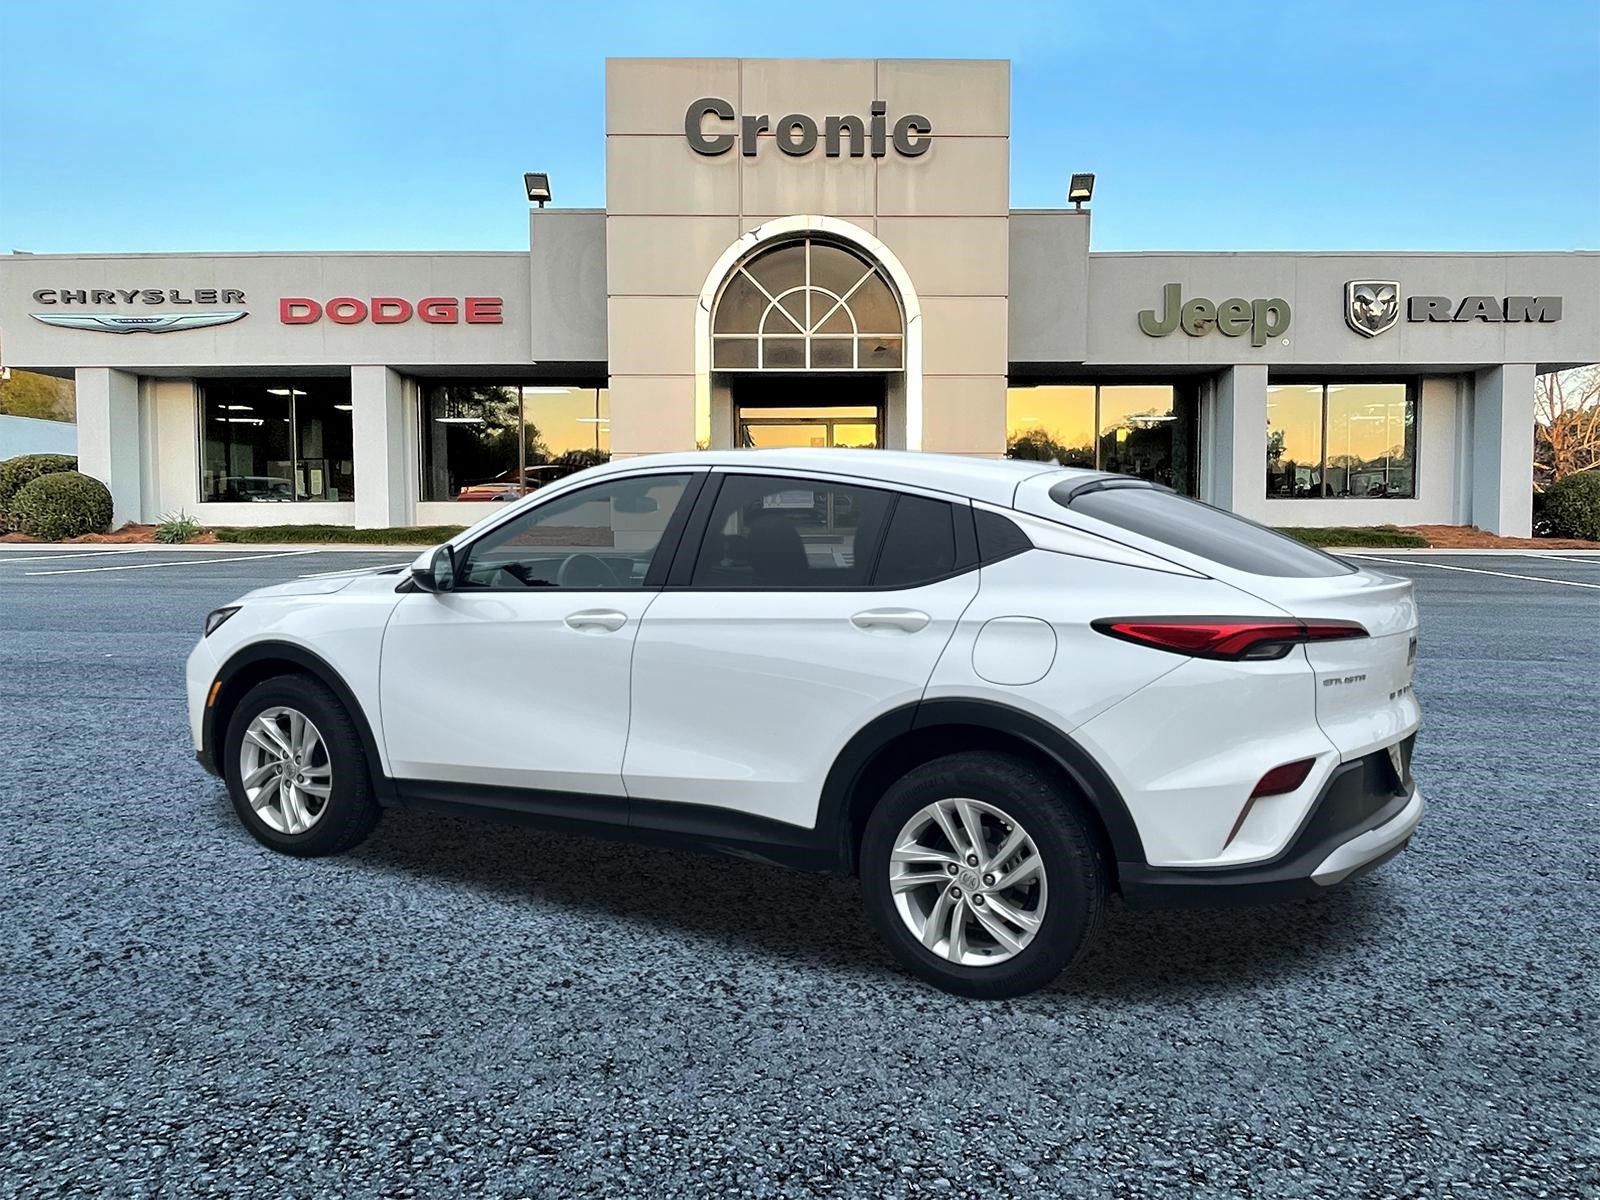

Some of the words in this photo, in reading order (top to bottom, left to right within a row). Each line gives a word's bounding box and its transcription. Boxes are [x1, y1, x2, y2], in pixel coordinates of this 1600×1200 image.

[684, 97, 932, 157] Cronic
[32, 289, 246, 304] CHRYSLER
[1407, 296, 1563, 322] RAM
[279, 297, 503, 324] DODGE
[1138, 283, 1291, 347] Jeep
